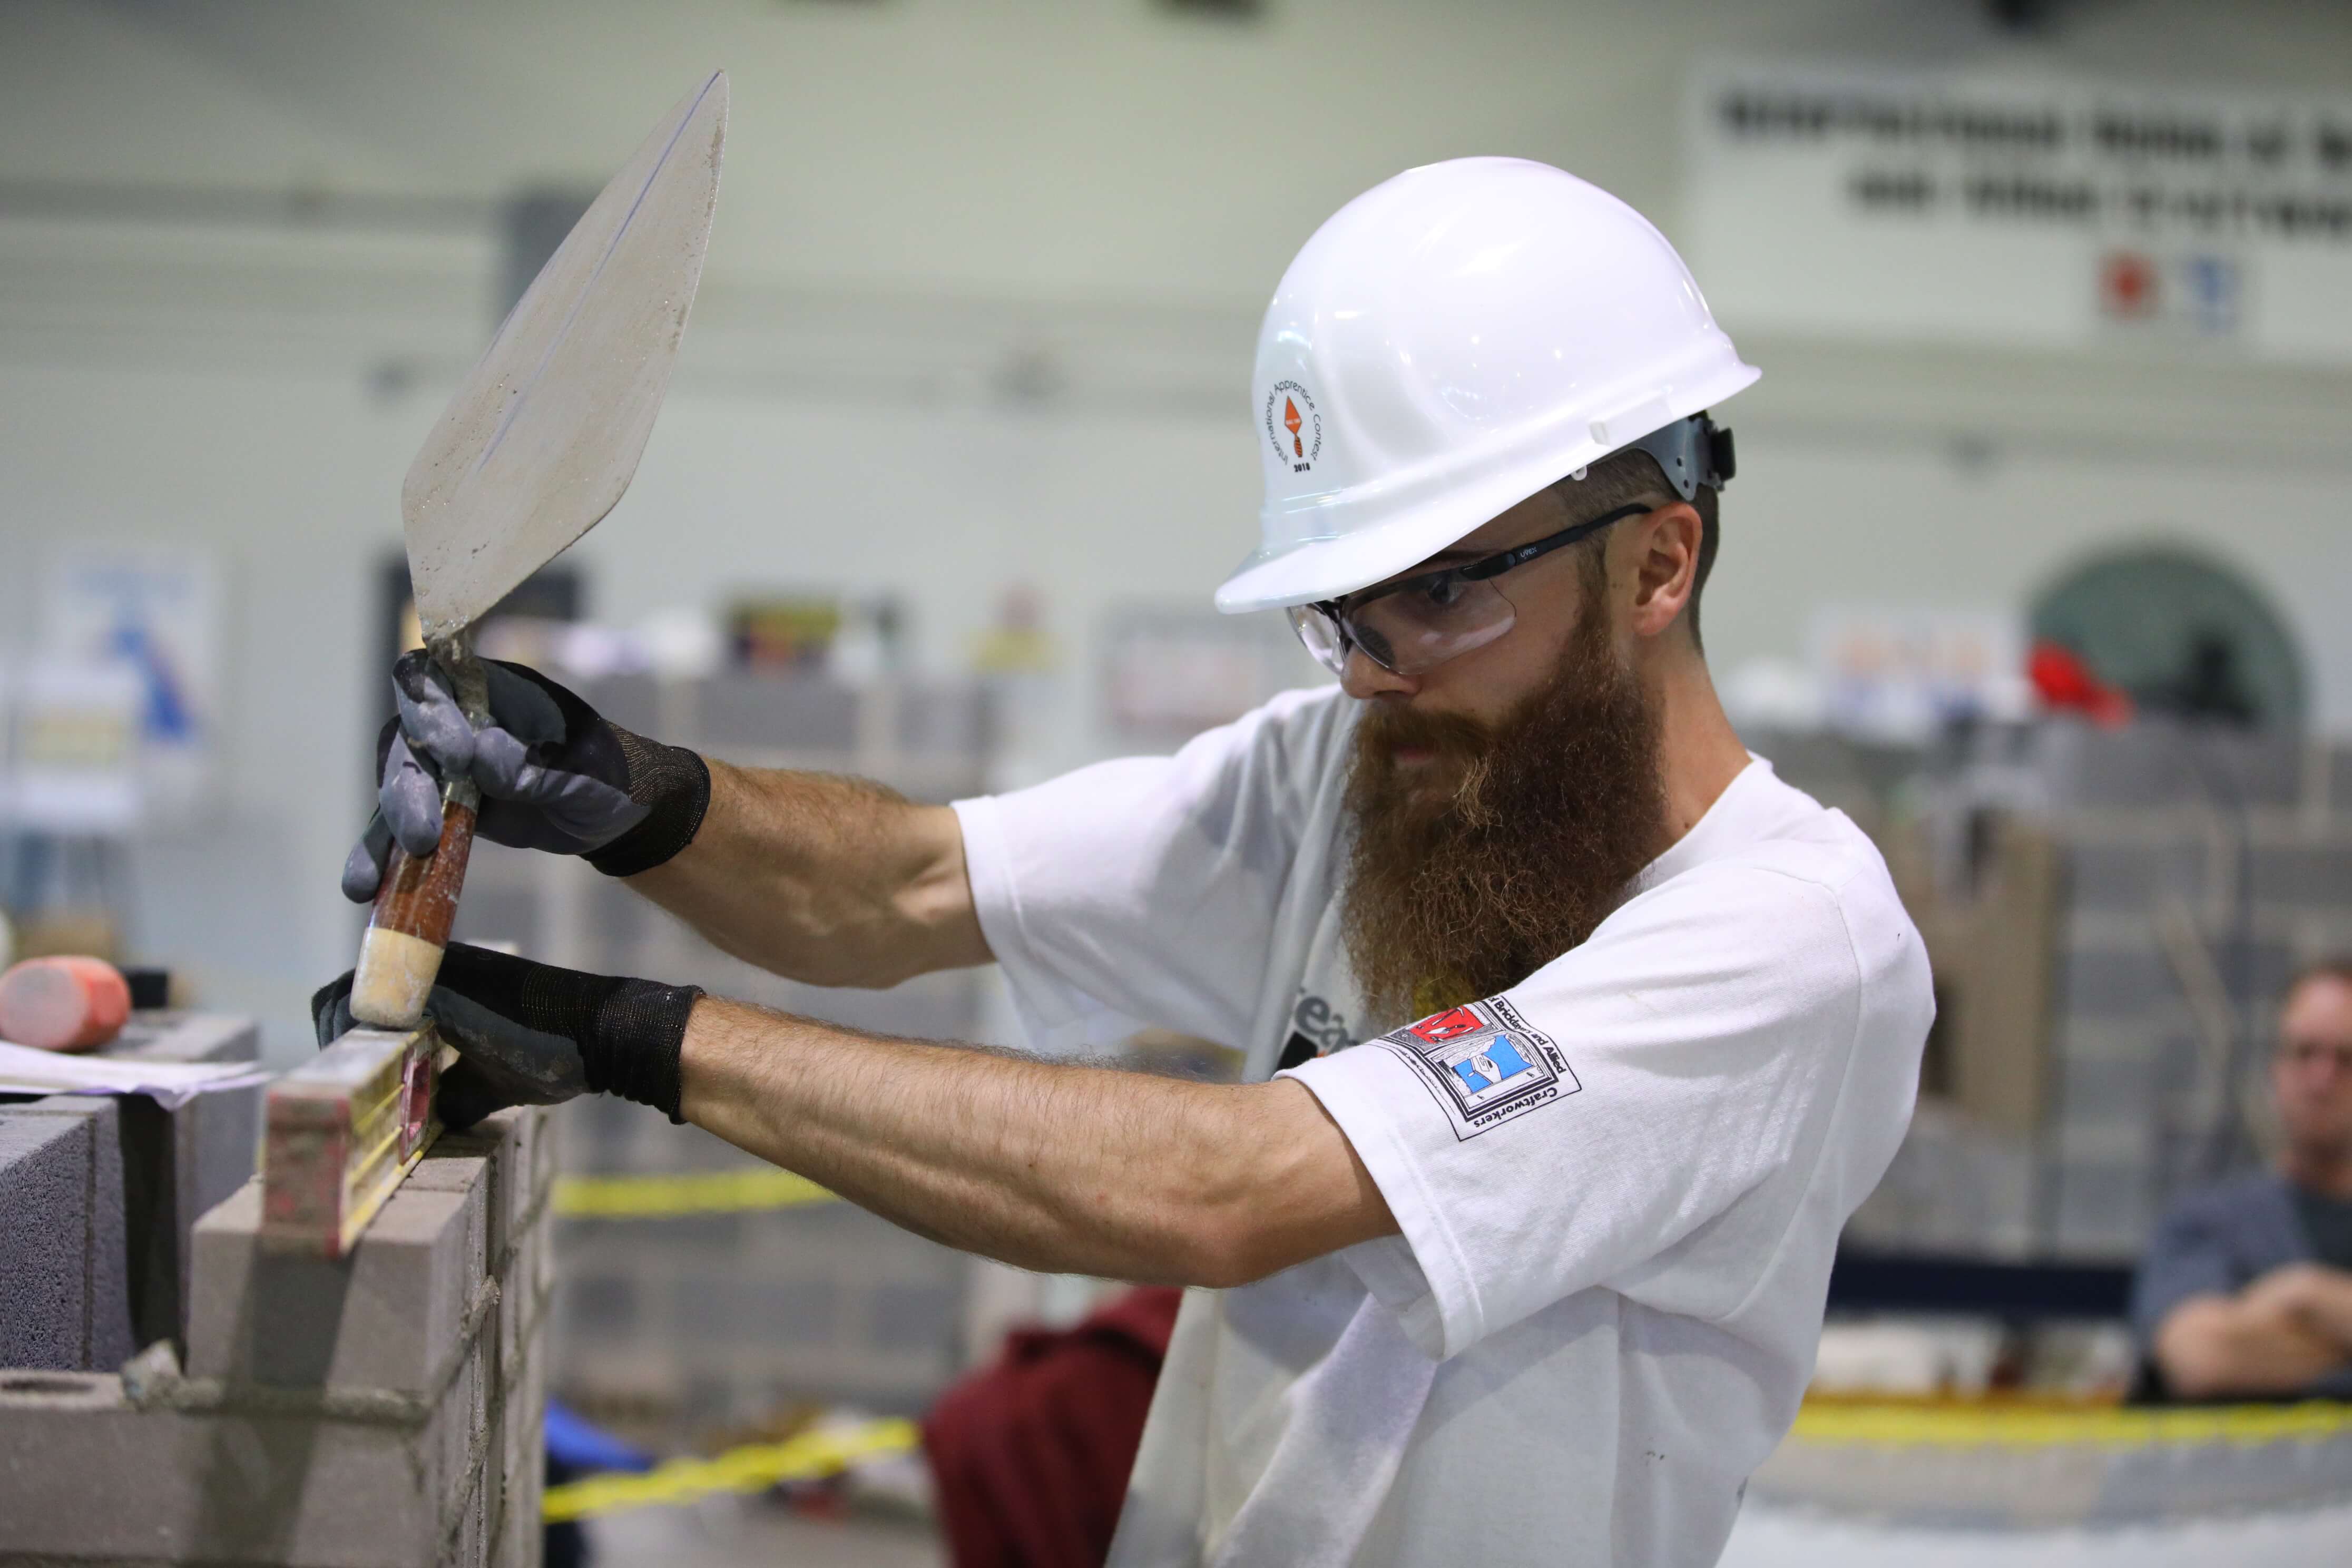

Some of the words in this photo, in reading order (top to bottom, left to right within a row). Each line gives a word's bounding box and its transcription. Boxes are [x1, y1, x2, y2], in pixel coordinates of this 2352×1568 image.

[1274, 380, 1315, 411] Apprentice
[1266, 391, 1288, 465] International
[1311, 414, 1321, 461] Contest
[1294, 463, 1310, 473] 2018
[1494, 1001, 1532, 1033] Bricklayers
[1531, 1034, 1549, 1046] and
[1543, 1046, 1567, 1074] Allied
[1474, 1087, 1557, 1128] Craftworkers
